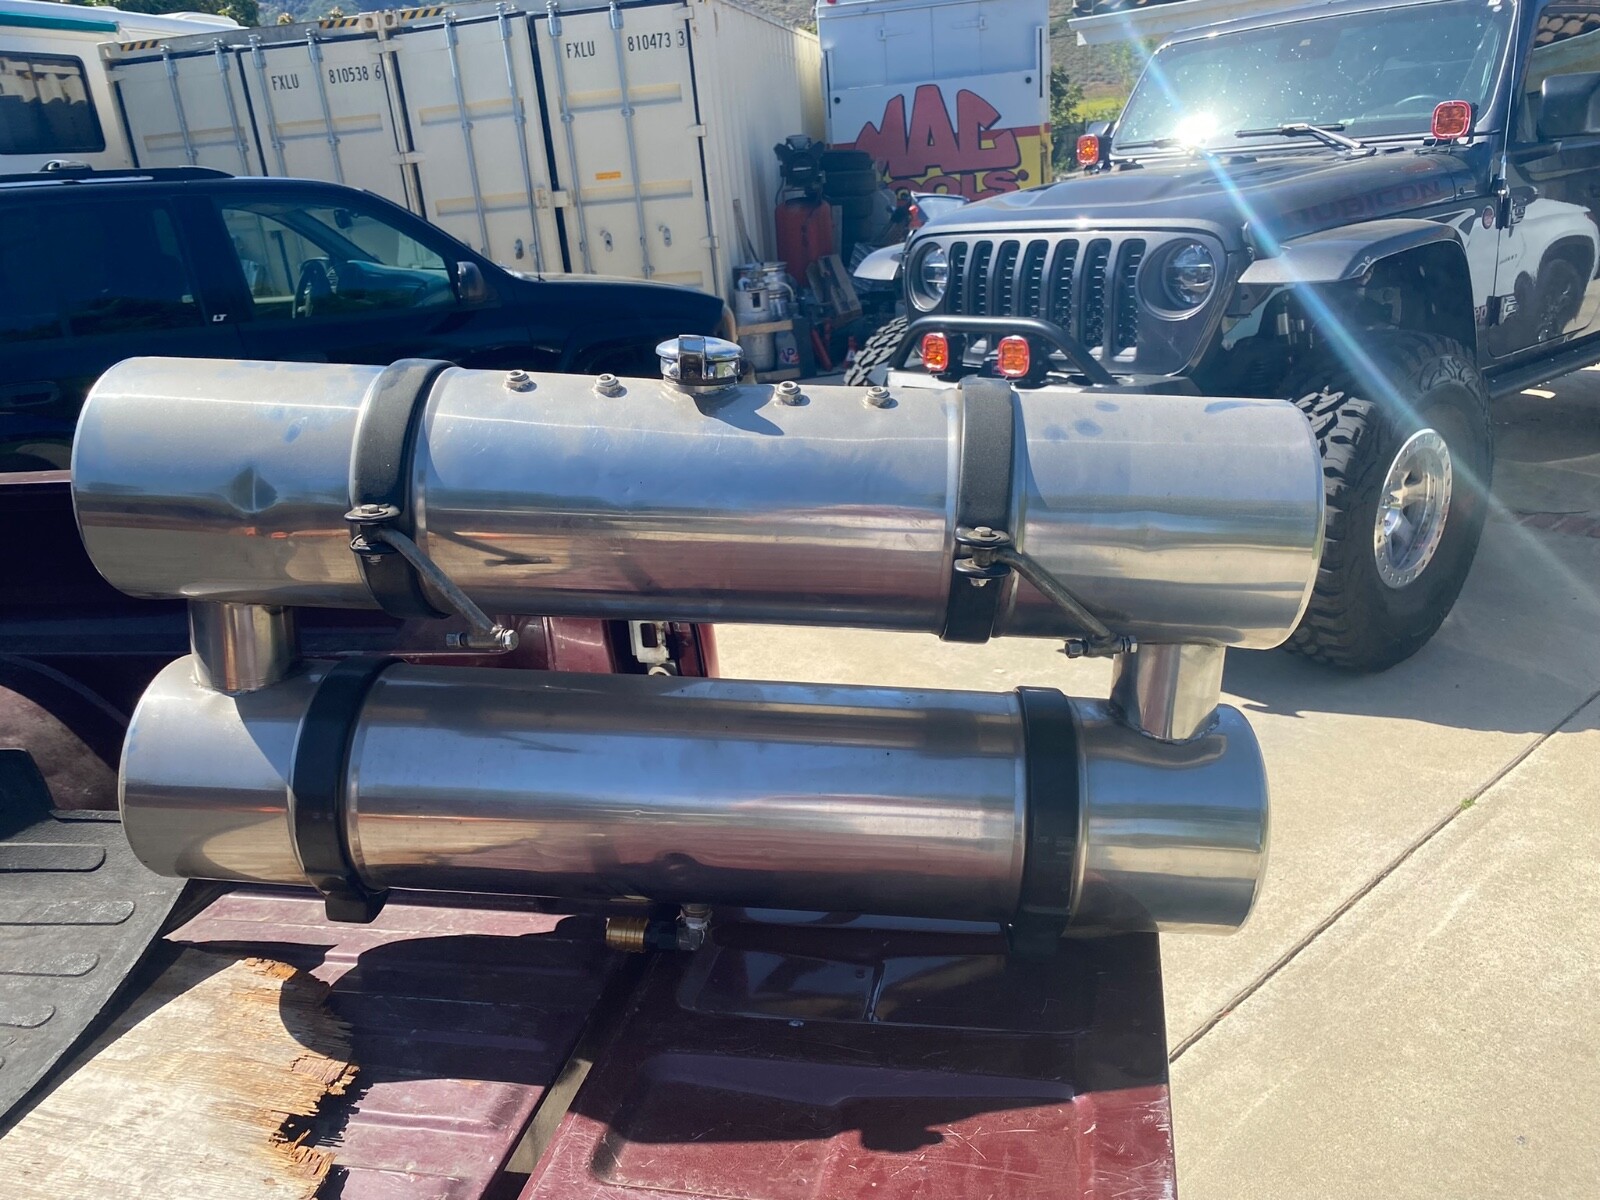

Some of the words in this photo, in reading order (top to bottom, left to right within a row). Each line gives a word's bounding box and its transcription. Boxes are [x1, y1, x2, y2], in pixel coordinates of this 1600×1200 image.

[566, 40, 596, 59] FXLU
[627, 32, 672, 52] 810473
[677, 30, 685, 47] 3
[271, 73, 299, 91] FXLU
[328, 65, 369, 84] 810538
[375, 64, 381, 80] 6
[854, 83, 1022, 178] MAC
[886, 169, 1020, 203] OOLS
